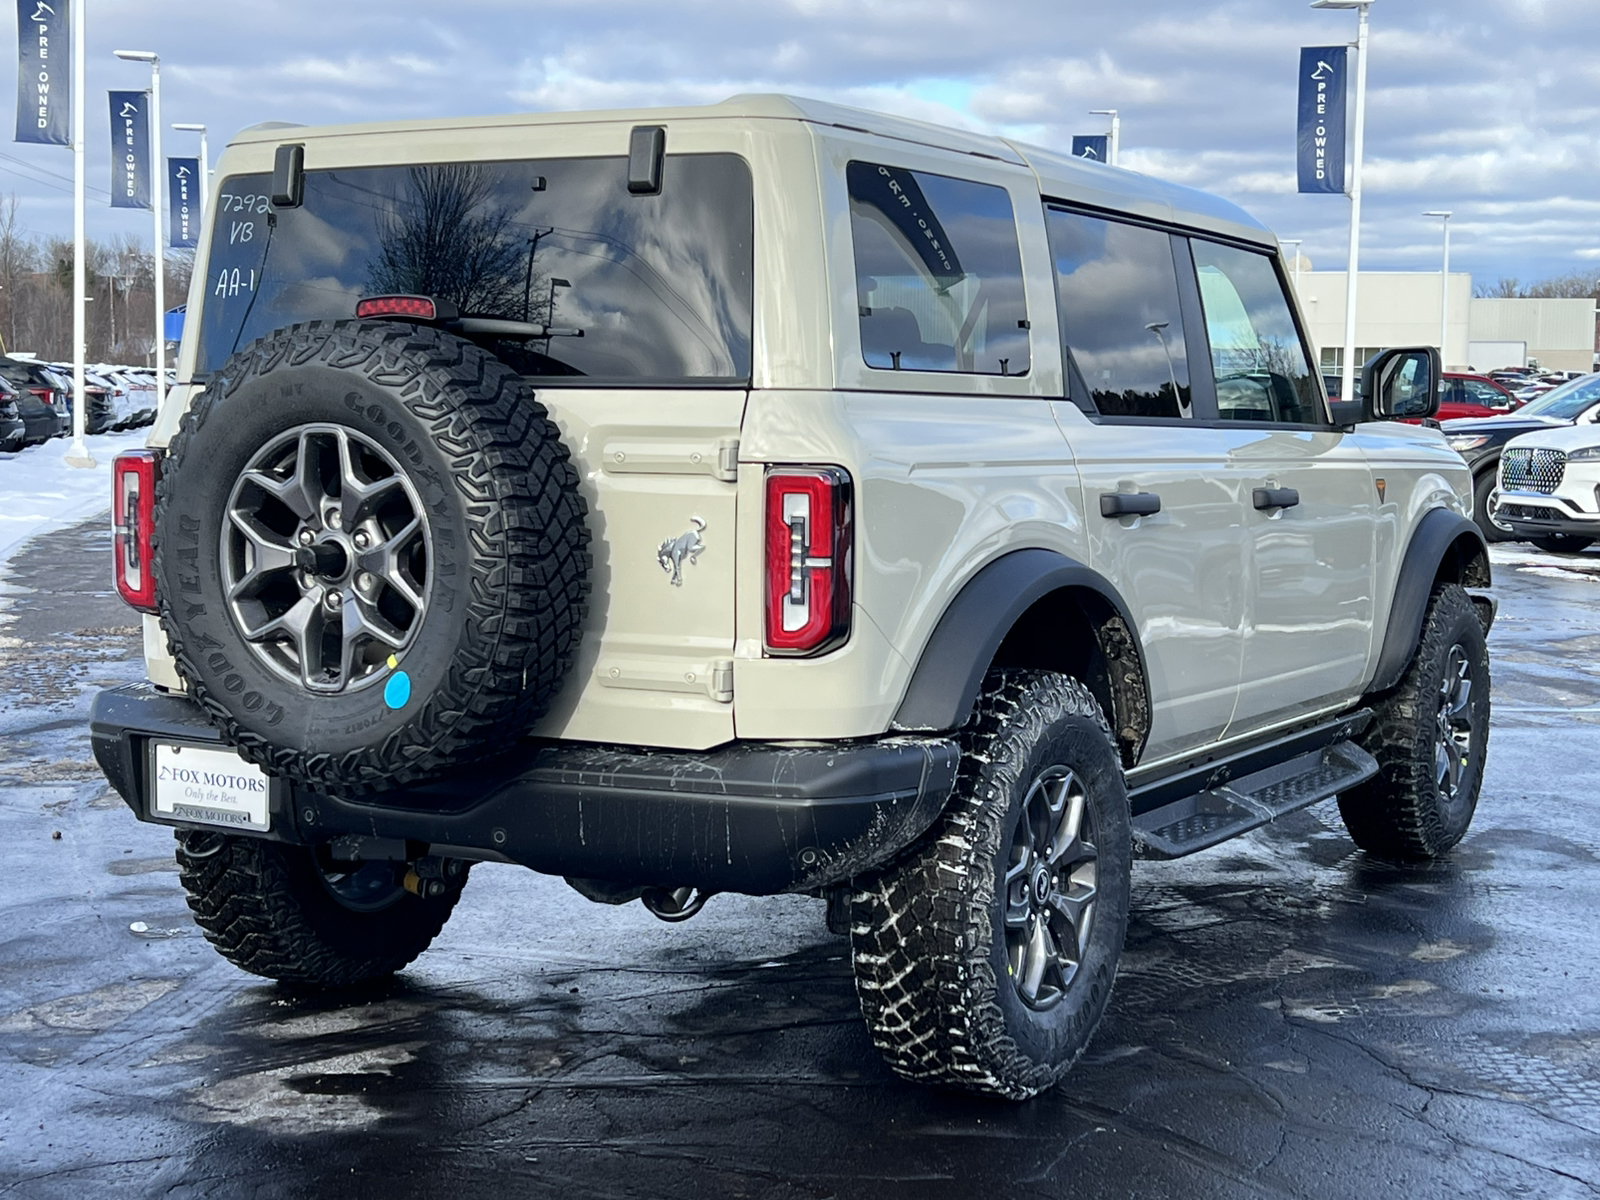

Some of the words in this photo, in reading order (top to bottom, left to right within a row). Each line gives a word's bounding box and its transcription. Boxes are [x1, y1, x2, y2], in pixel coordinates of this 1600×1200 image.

[221, 194, 272, 213] 7292
[230, 222, 254, 244] VB
[172, 767, 200, 784] FOX
[203, 772, 265, 792] MOTORS
[185, 787, 202, 802] Only
[206, 790, 218, 802] the
[185, 808, 200, 819] FOX
[205, 809, 243, 824] MOTORS
